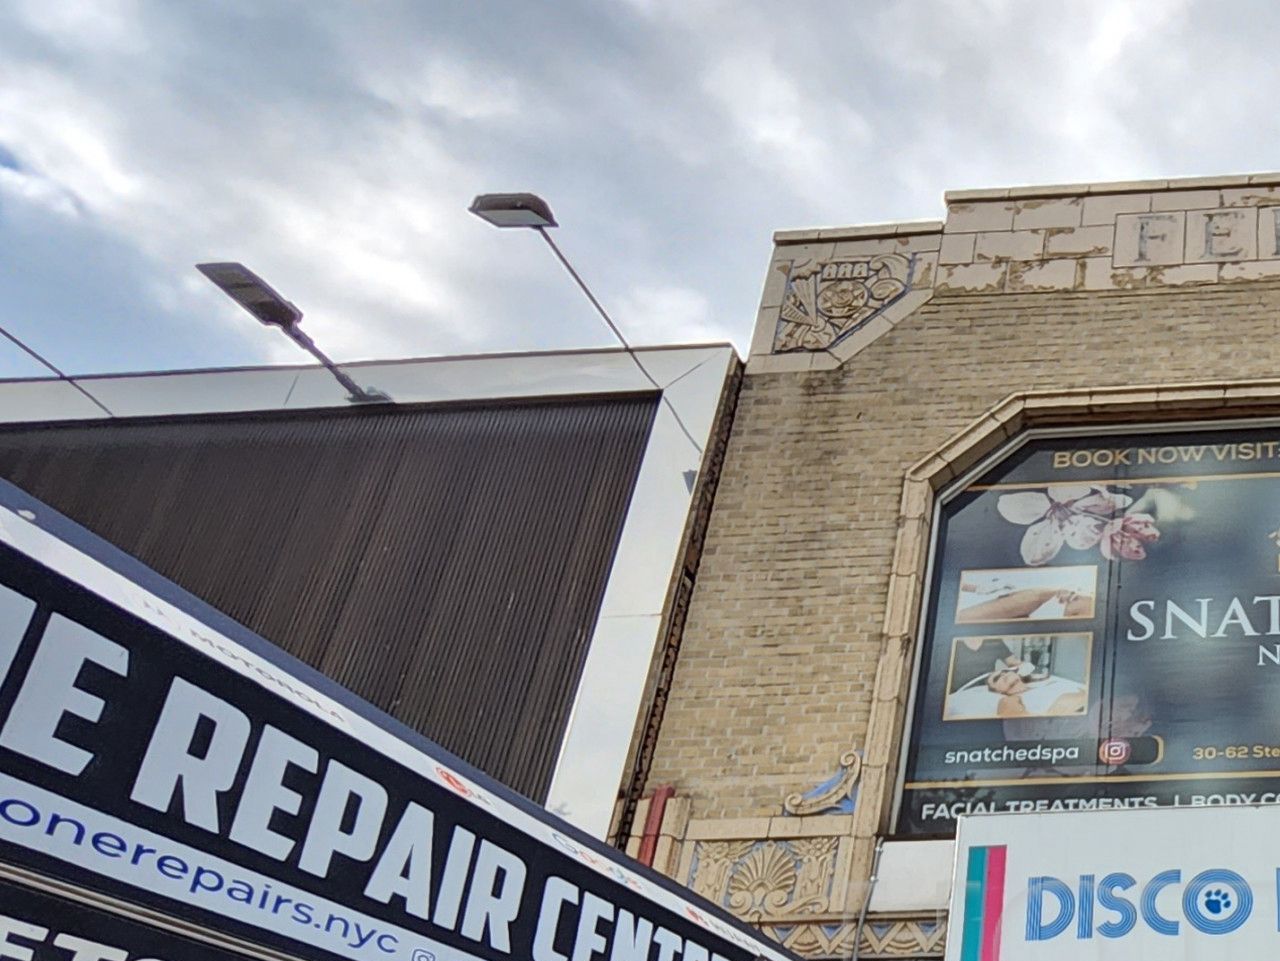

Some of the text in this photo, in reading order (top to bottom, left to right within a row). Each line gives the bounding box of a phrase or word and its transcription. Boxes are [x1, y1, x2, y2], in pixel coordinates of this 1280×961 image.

[1053, 449, 1130, 469] BOOK
[1138, 446, 1200, 466] NOW
[945, 745, 1080, 764] snatchedspa
[1193, 746, 1247, 760] 30-62
[130, 676, 527, 955] REPAIR
[1025, 866, 1254, 942] DISCO
